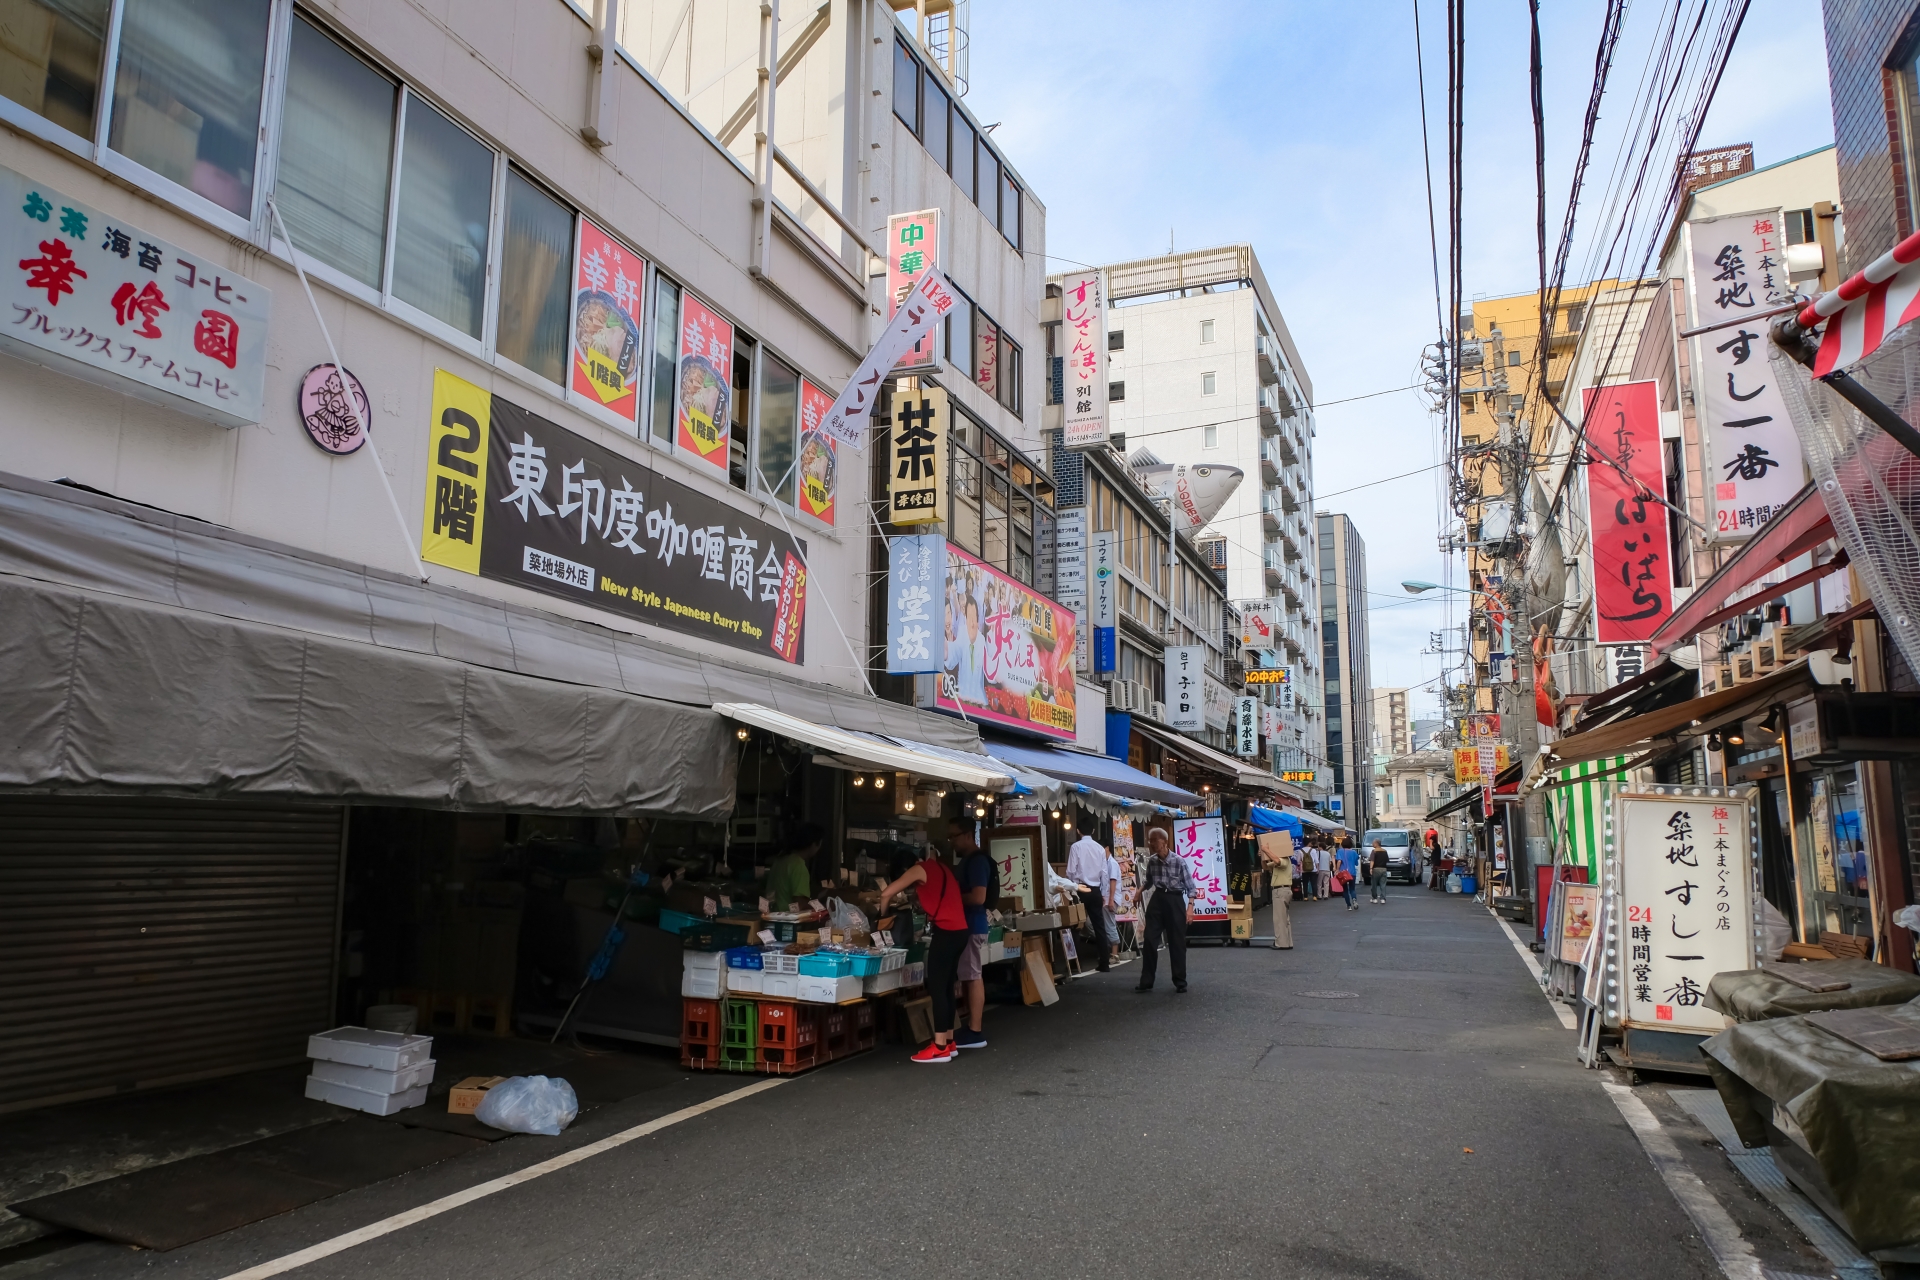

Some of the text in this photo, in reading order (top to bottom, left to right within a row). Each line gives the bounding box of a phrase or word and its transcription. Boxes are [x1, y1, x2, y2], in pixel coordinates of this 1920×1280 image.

[1694, 161, 1741, 176] 東銀座
[22, 191, 248, 304] お茶 海苔 コーヒー
[603, 242, 622, 264] 築地
[582, 248, 638, 315] 幸軒
[1753, 219, 1779, 322] 極上本まぐ
[700, 311, 715, 330] 築地
[1066, 281, 1096, 379] すしざんまい
[619, 335, 634, 370] ラーメン
[685, 318, 728, 374] 幸軒
[589, 360, 621, 392] 1階奥
[714, 392, 725, 427] ラーメン
[1076, 385, 1092, 415] 別館
[690, 416, 716, 444] 1階奥
[894, 398, 938, 481] 茶
[1067, 422, 1102, 434] 24h OPEN
[433, 408, 481, 545] 2階
[808, 484, 826, 505] 1階奥
[500, 432, 784, 608] 東印度咖喱商会
[1718, 504, 1786, 531] 24時間営
[529, 552, 589, 587] 築地場外店
[898, 547, 912, 582] えび
[918, 545, 932, 581] 冷凍品
[1599, 492, 1662, 621] はいばら
[601, 576, 762, 639] New Style Japanese Curry Shop
[774, 559, 796, 651] おかわり自由
[1099, 581, 1107, 619] マーケット
[1178, 652, 1190, 712] 包丁 子の日
[1030, 701, 1073, 730] 24時間年中無休
[1177, 821, 1227, 906] すしざんまい
[1711, 805, 1731, 931] 極上本まぐろの店
[1204, 907, 1227, 915] OPEN
[1628, 905, 1653, 1003] 24時間営業
